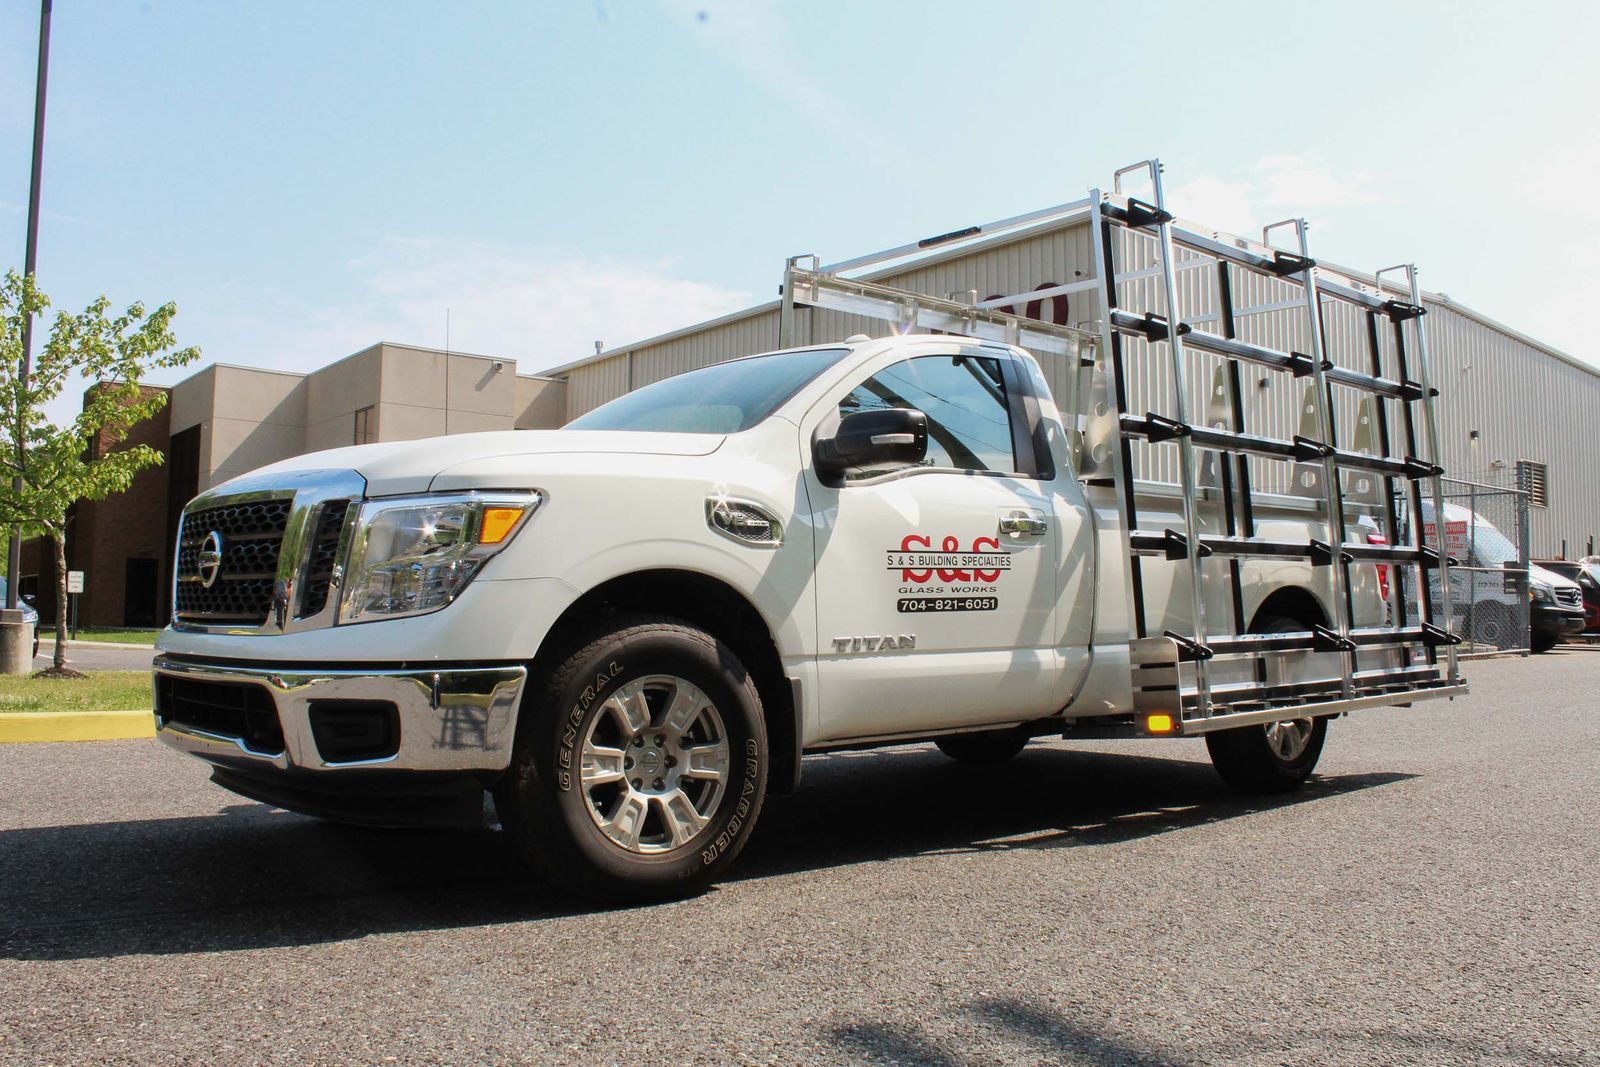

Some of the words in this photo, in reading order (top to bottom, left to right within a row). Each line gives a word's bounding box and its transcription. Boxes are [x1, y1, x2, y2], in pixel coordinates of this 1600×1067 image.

[887, 555, 894, 566] S
[898, 556, 904, 566] &
[908, 555, 915, 566] S
[919, 555, 958, 567] BUILDING
[961, 556, 1011, 567] SPECIALTIES
[901, 534, 1001, 583] S&S
[898, 586, 944, 594] GLASS
[901, 598, 996, 612] 704-821-6051
[831, 633, 916, 653] TITAN
[558, 660, 625, 792] GENERAL
[702, 737, 758, 866] GRABBER
